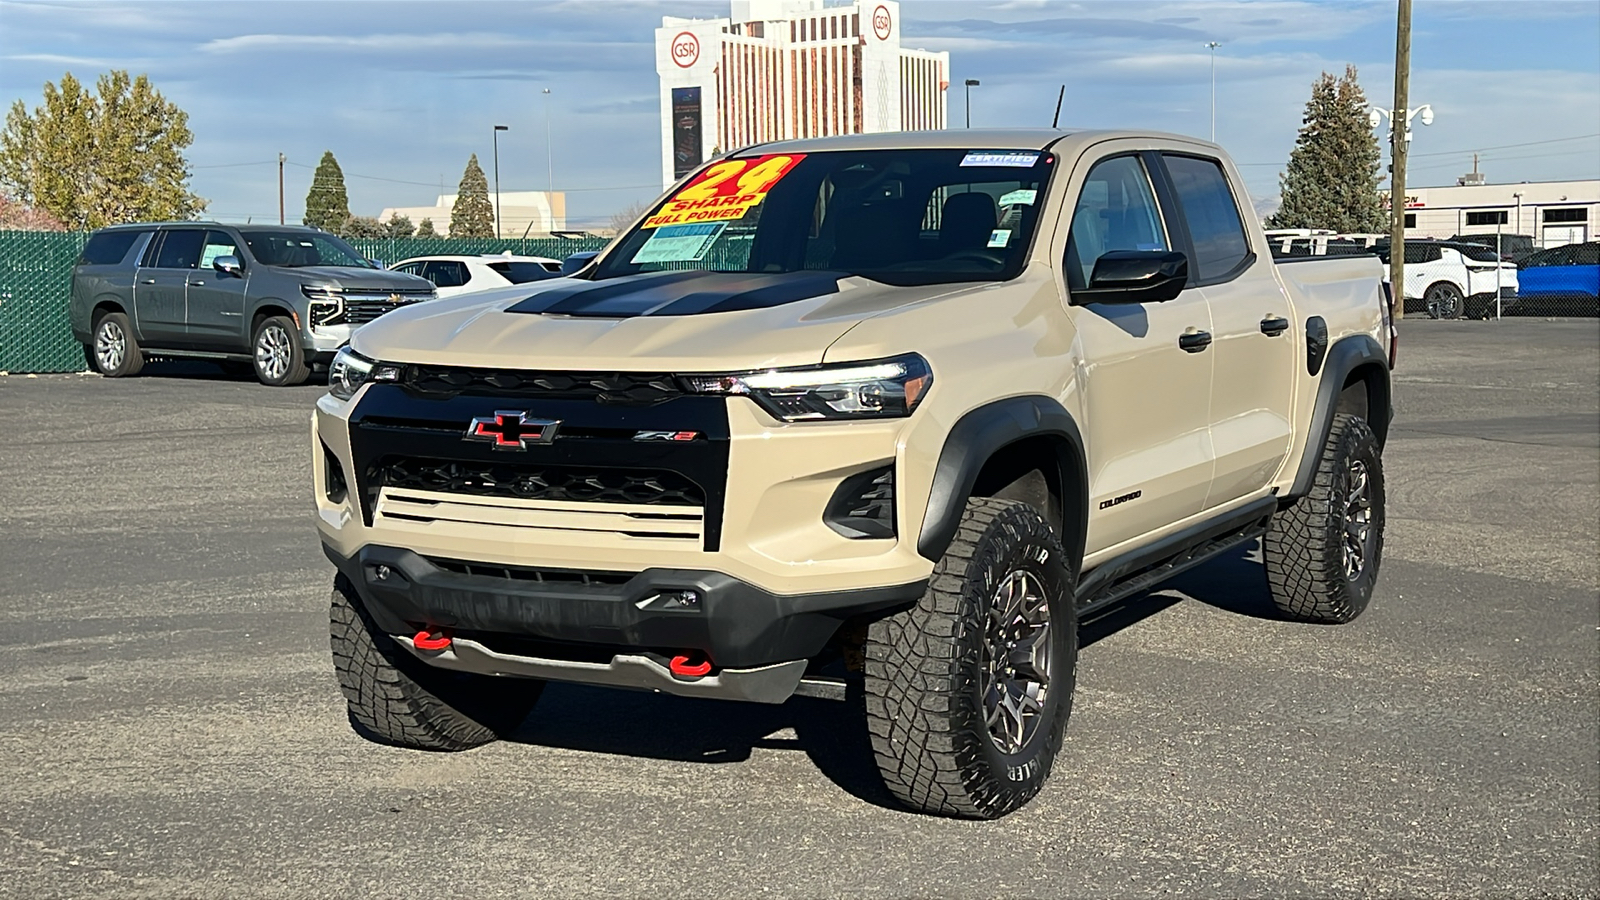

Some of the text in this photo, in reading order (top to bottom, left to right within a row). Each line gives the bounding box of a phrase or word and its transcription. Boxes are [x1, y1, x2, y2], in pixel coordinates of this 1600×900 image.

[876, 15, 889, 31] GSR
[674, 42, 696, 58] GSR
[966, 154, 1035, 163] CERTIFIED
[676, 156, 793, 201] 24
[671, 194, 757, 212] SHARP
[645, 207, 744, 228] FULL POWER
[631, 430, 698, 441] ZR2
[1099, 489, 1142, 510] COLORADO
